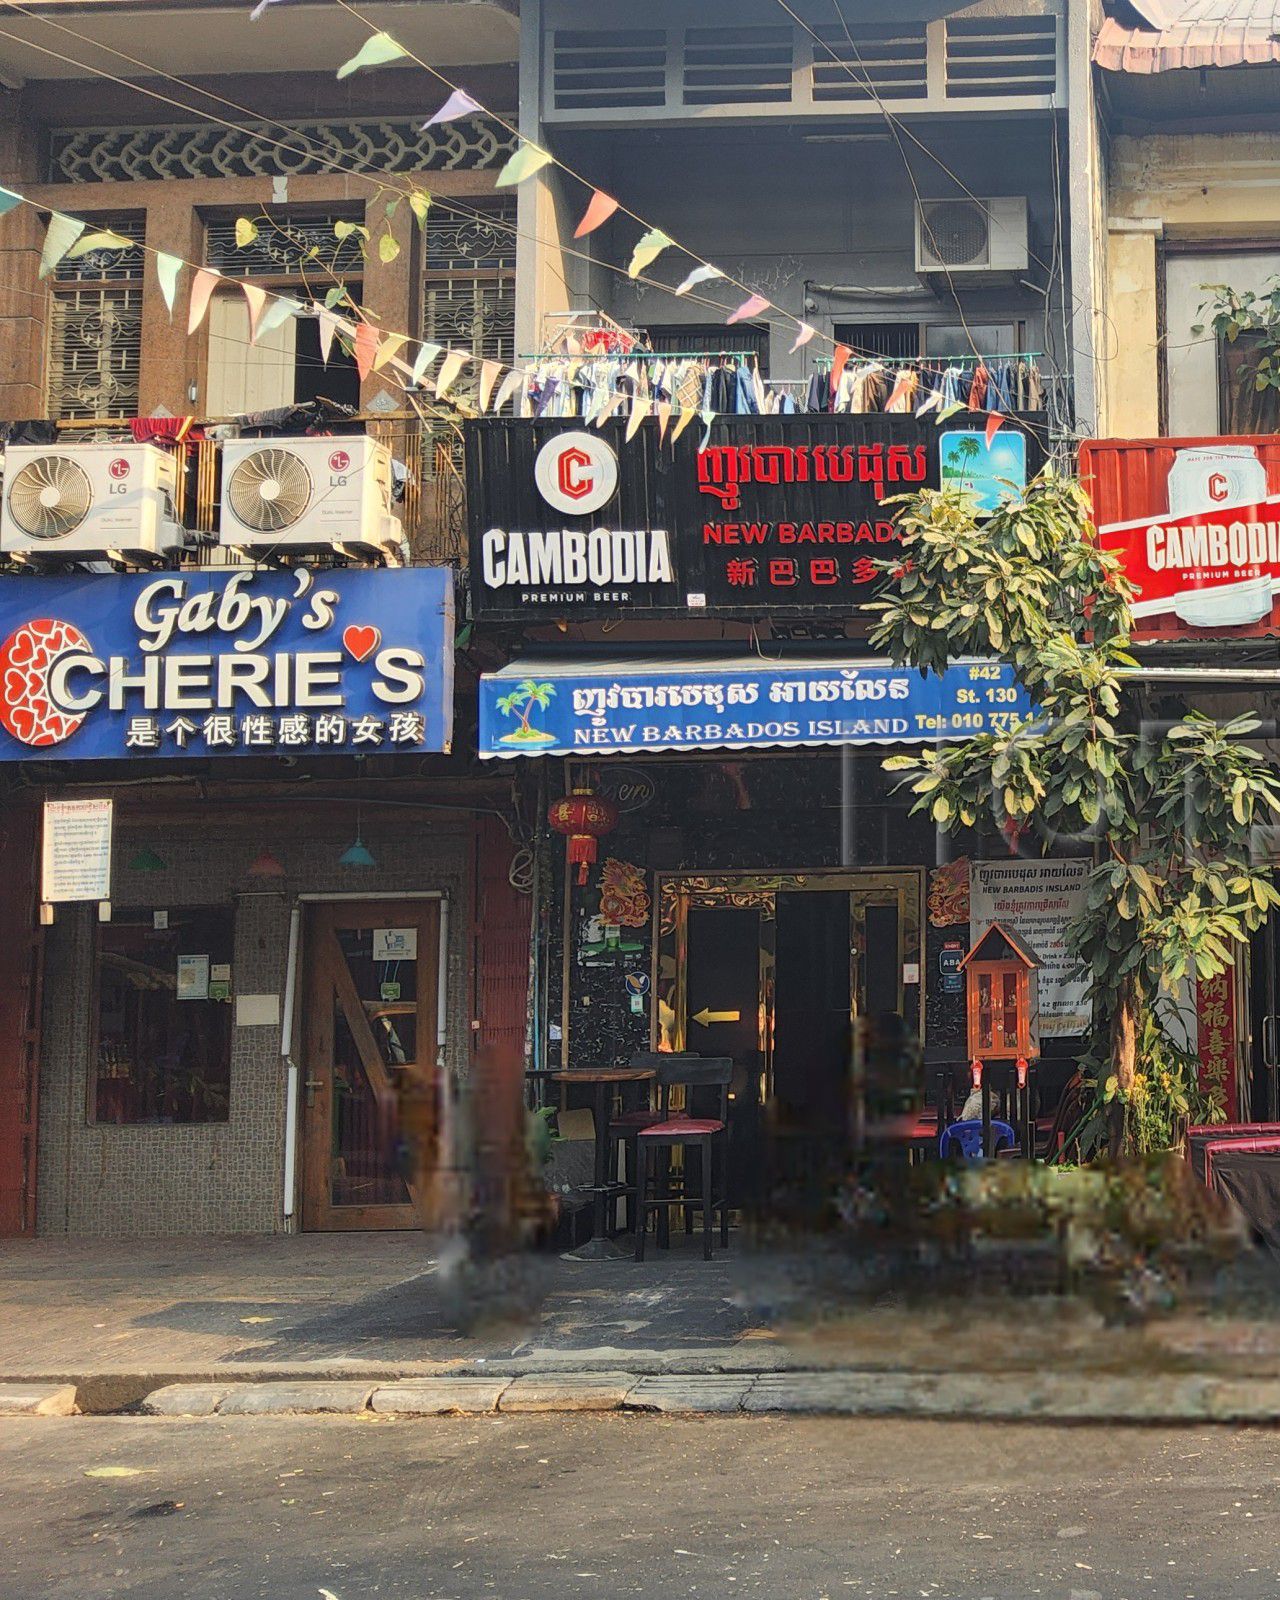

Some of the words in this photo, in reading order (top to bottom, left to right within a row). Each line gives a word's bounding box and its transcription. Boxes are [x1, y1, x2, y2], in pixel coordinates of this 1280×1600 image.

[109, 484, 127, 495] LG
[329, 476, 347, 487] LG
[703, 521, 769, 545] NEW
[778, 521, 904, 545] BARBAD
[482, 527, 675, 590] CAMBODIA
[1182, 571, 1230, 581] PREMIUM
[1234, 569, 1262, 579] BEER
[521, 592, 585, 603] PREMIUM
[593, 592, 631, 602] BEER
[134, 567, 340, 652] Gaby's
[969, 666, 1001, 681] #42
[956, 688, 981, 704] St.
[986, 687, 1018, 703] 130
[915, 714, 947, 730] Tel:
[951, 713, 984, 729] 010
[988, 712, 1020, 729] 775
[126, 712, 424, 748] 是个很性感的女孩
[573, 724, 637, 745] NEW
[643, 720, 801, 743] BARBADOS
[808, 717, 909, 737] ISLAND
[982, 886, 1002, 894] NEW
[1045, 884, 1081, 893] INSLAND
